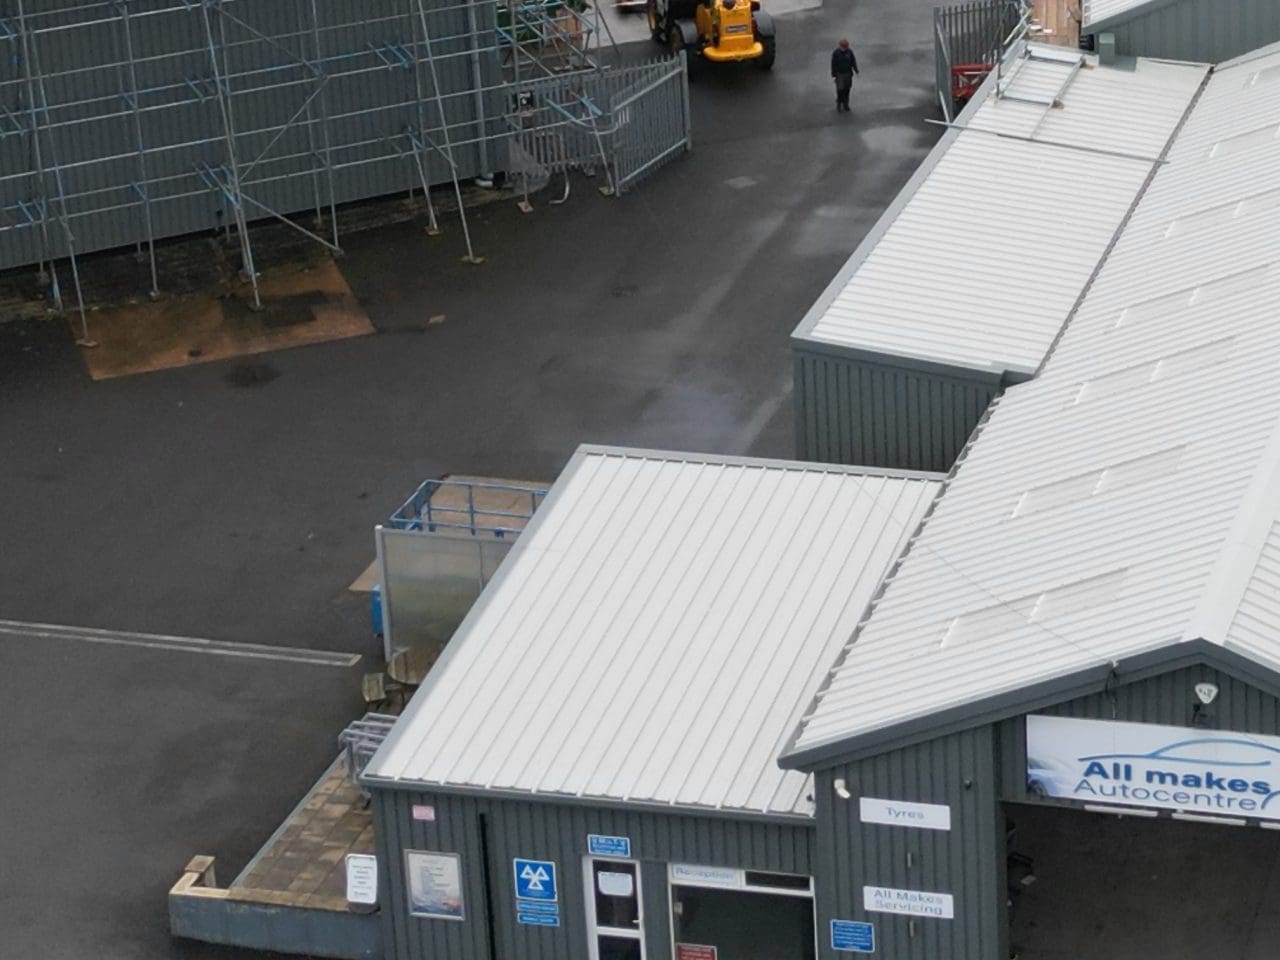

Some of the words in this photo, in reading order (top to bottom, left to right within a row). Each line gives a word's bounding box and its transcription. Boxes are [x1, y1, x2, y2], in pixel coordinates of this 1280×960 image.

[1084, 762, 1132, 781] All
[1146, 770, 1271, 795] makes
[1073, 779, 1256, 811] Autocentre
[886, 807, 924, 819] Tyres
[874, 889, 891, 898] All
[897, 892, 944, 904] Makes
[875, 900, 943, 915] Servicing
